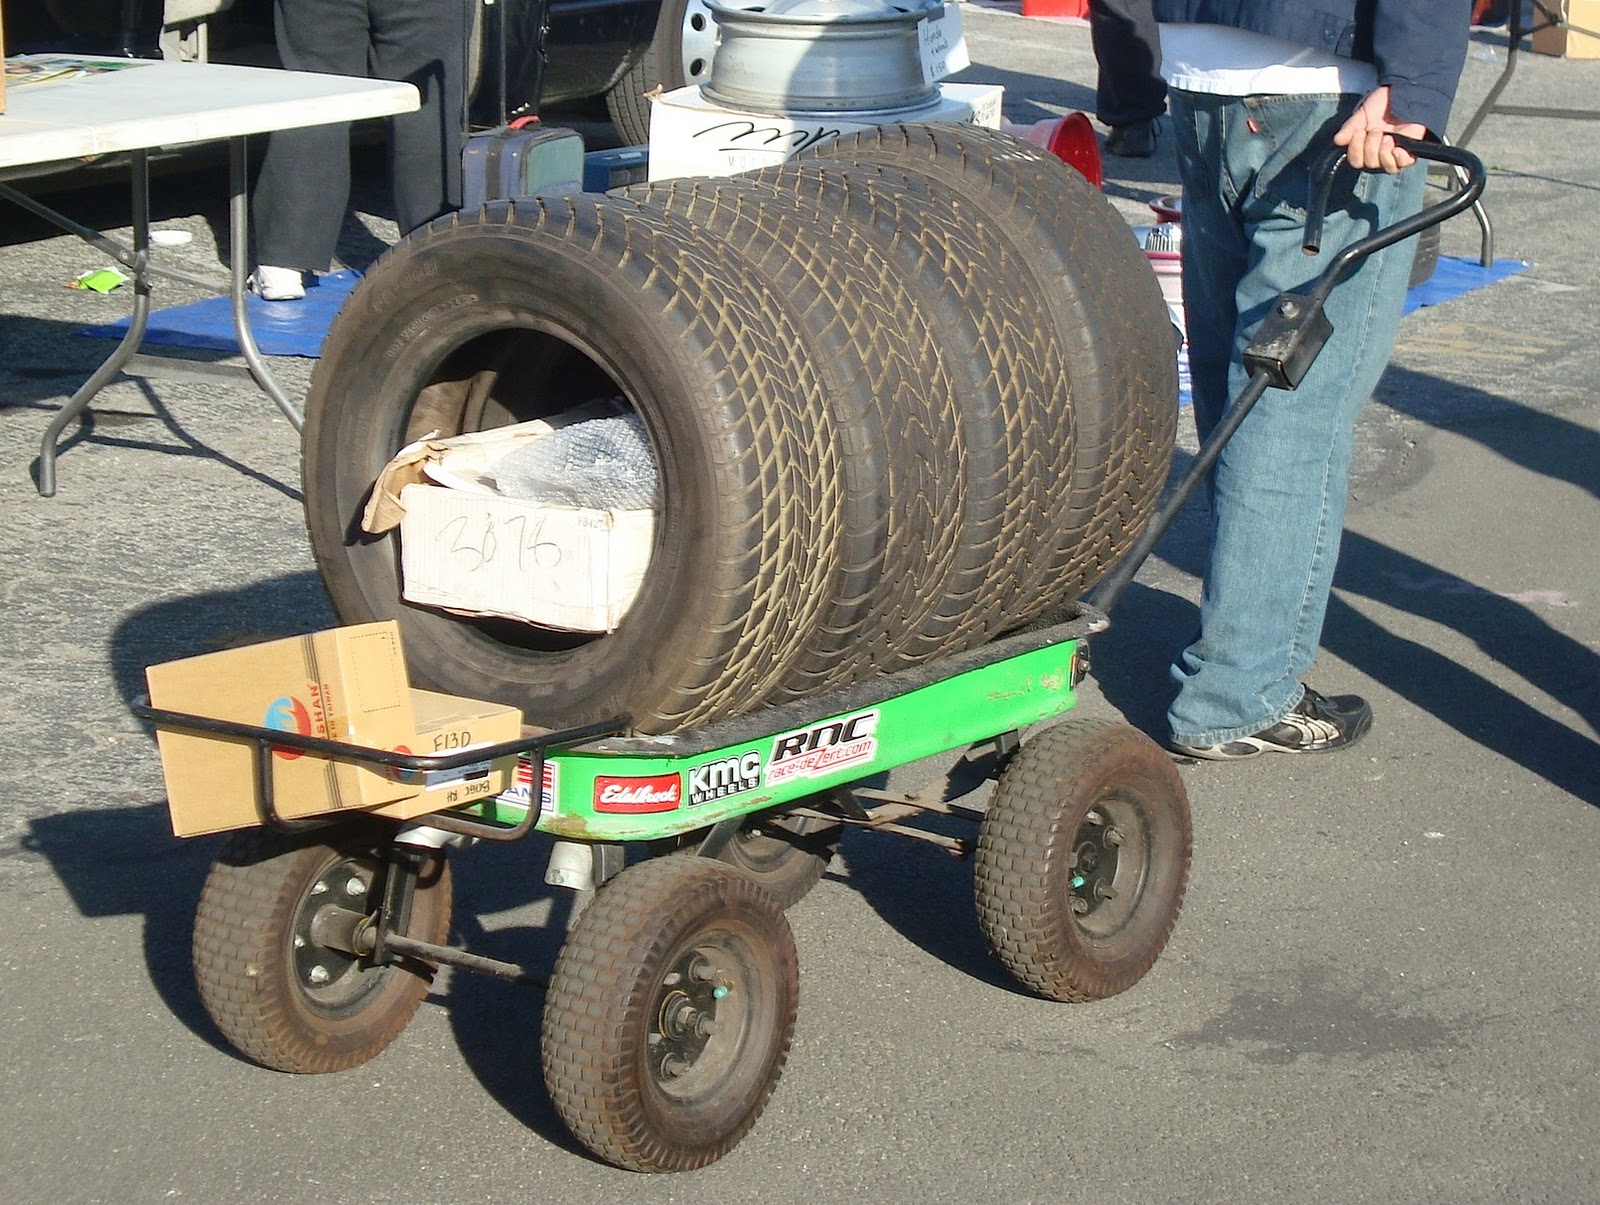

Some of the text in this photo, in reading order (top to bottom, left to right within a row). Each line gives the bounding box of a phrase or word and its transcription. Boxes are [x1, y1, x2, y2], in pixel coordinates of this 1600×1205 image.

[308, 683, 326, 740] SHAN
[322, 683, 334, 717] TAIWAN
[600, 784, 678, 804] Edelbrock
[690, 777, 758, 805] WHEELS
